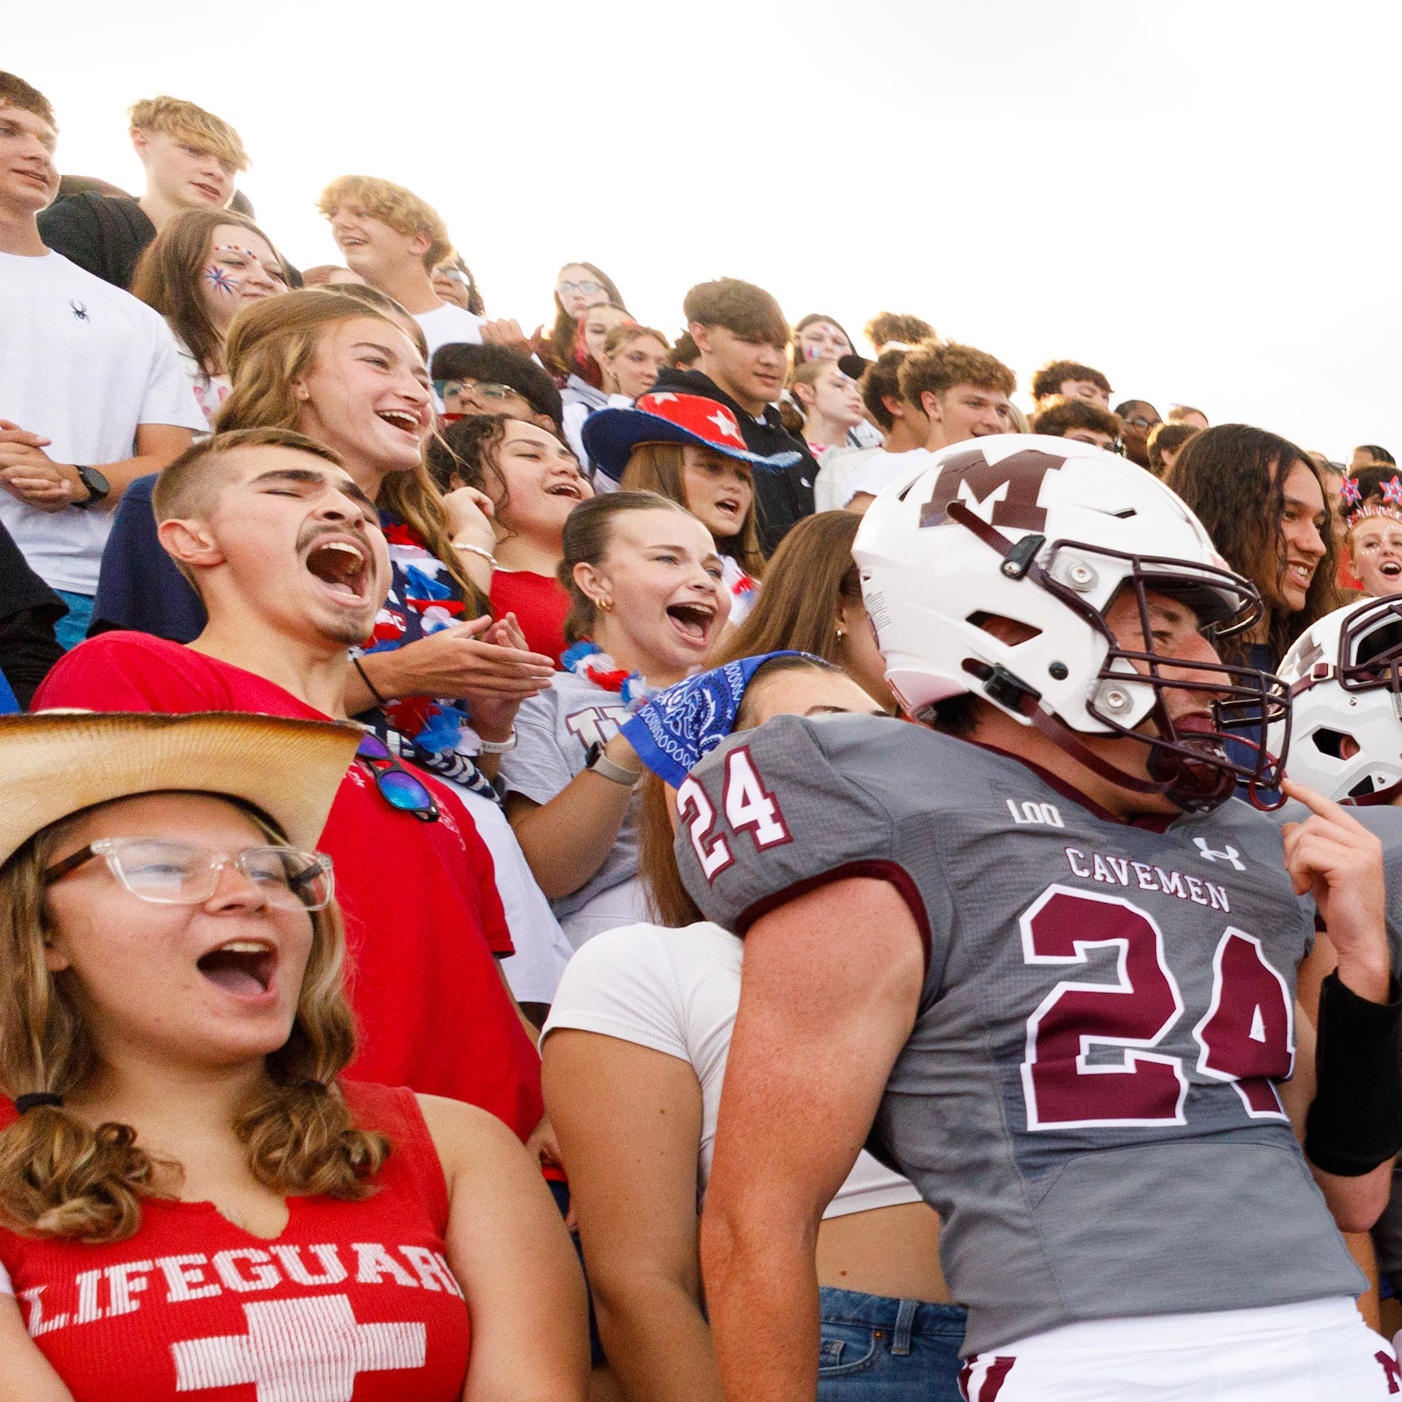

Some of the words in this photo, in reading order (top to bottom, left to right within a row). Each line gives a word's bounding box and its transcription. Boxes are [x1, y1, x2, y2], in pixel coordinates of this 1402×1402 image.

[919, 449, 1067, 532] M
[677, 746, 793, 885] 24
[1065, 846, 1231, 913] CAVEMEN
[1019, 883, 1297, 1132] 24
[23, 1243, 465, 1337] LIFEGUAR
